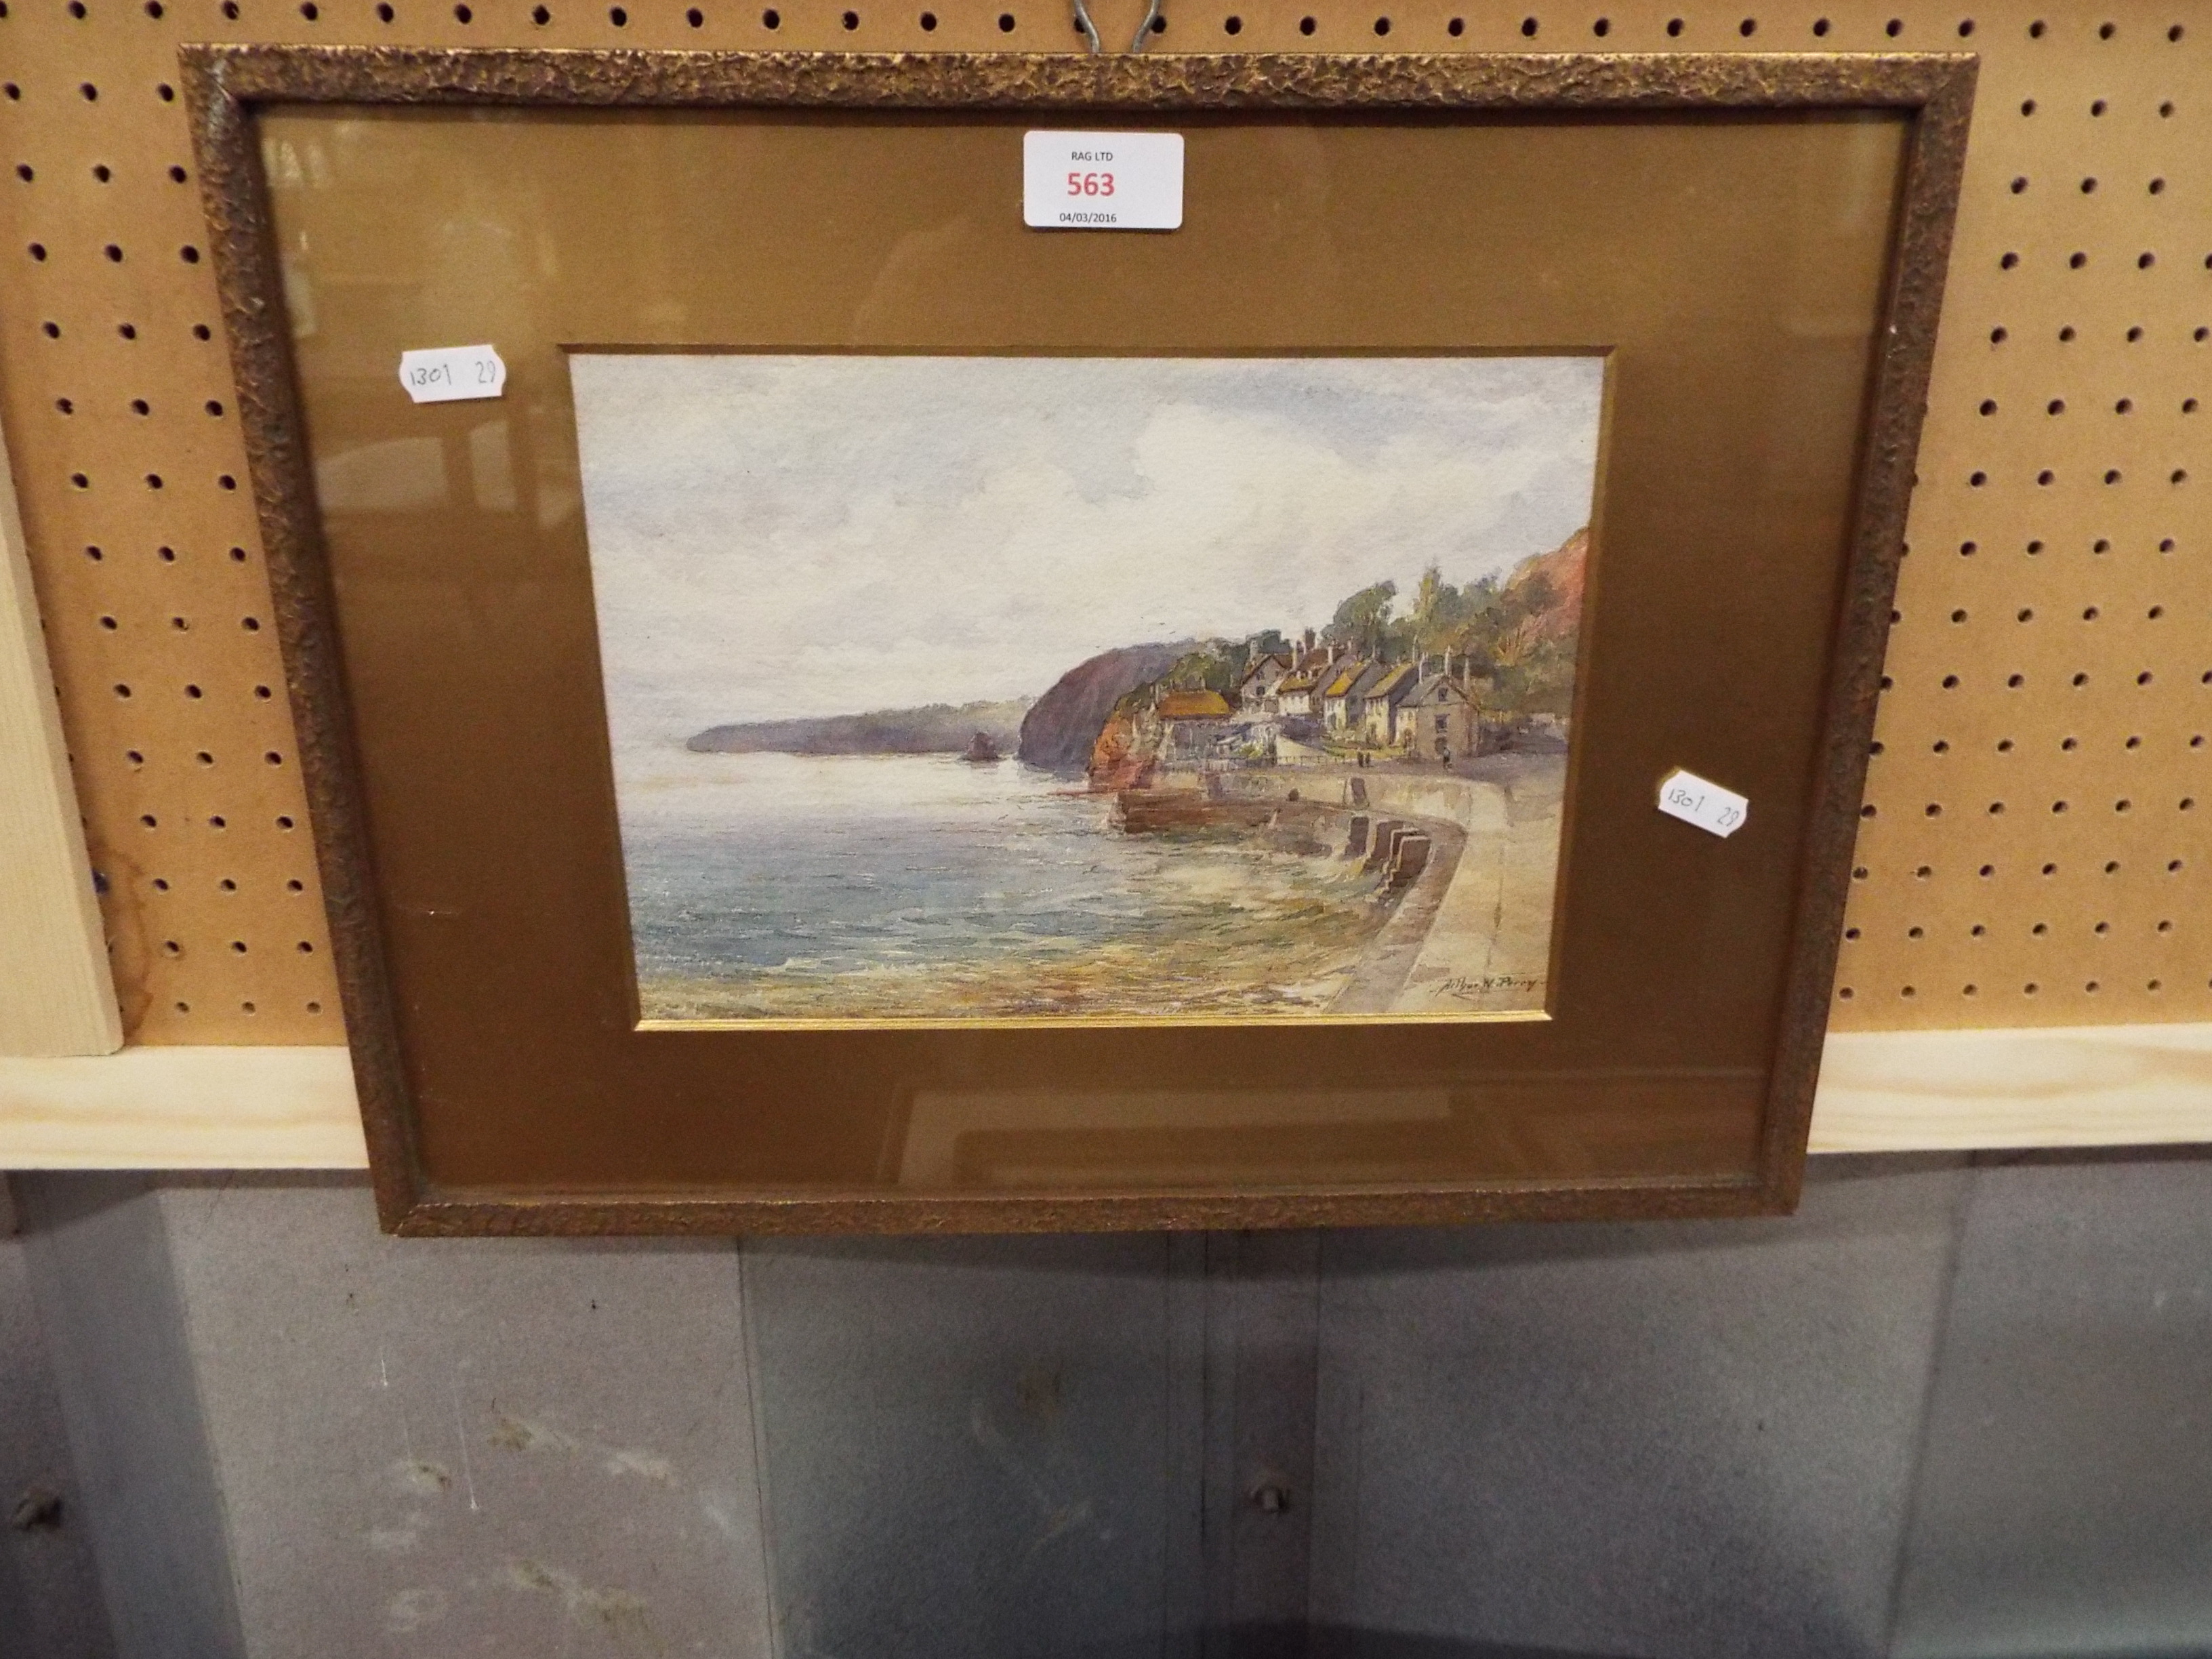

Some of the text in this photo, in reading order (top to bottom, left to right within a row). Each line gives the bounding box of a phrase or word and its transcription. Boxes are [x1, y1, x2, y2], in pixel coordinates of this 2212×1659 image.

[1071, 152, 1113, 161] RAG LTD
[1067, 172, 1115, 196] 563
[1059, 212, 1117, 223] 04/03/2016
[410, 363, 451, 386] 1301
[1668, 788, 1705, 812] 1301
